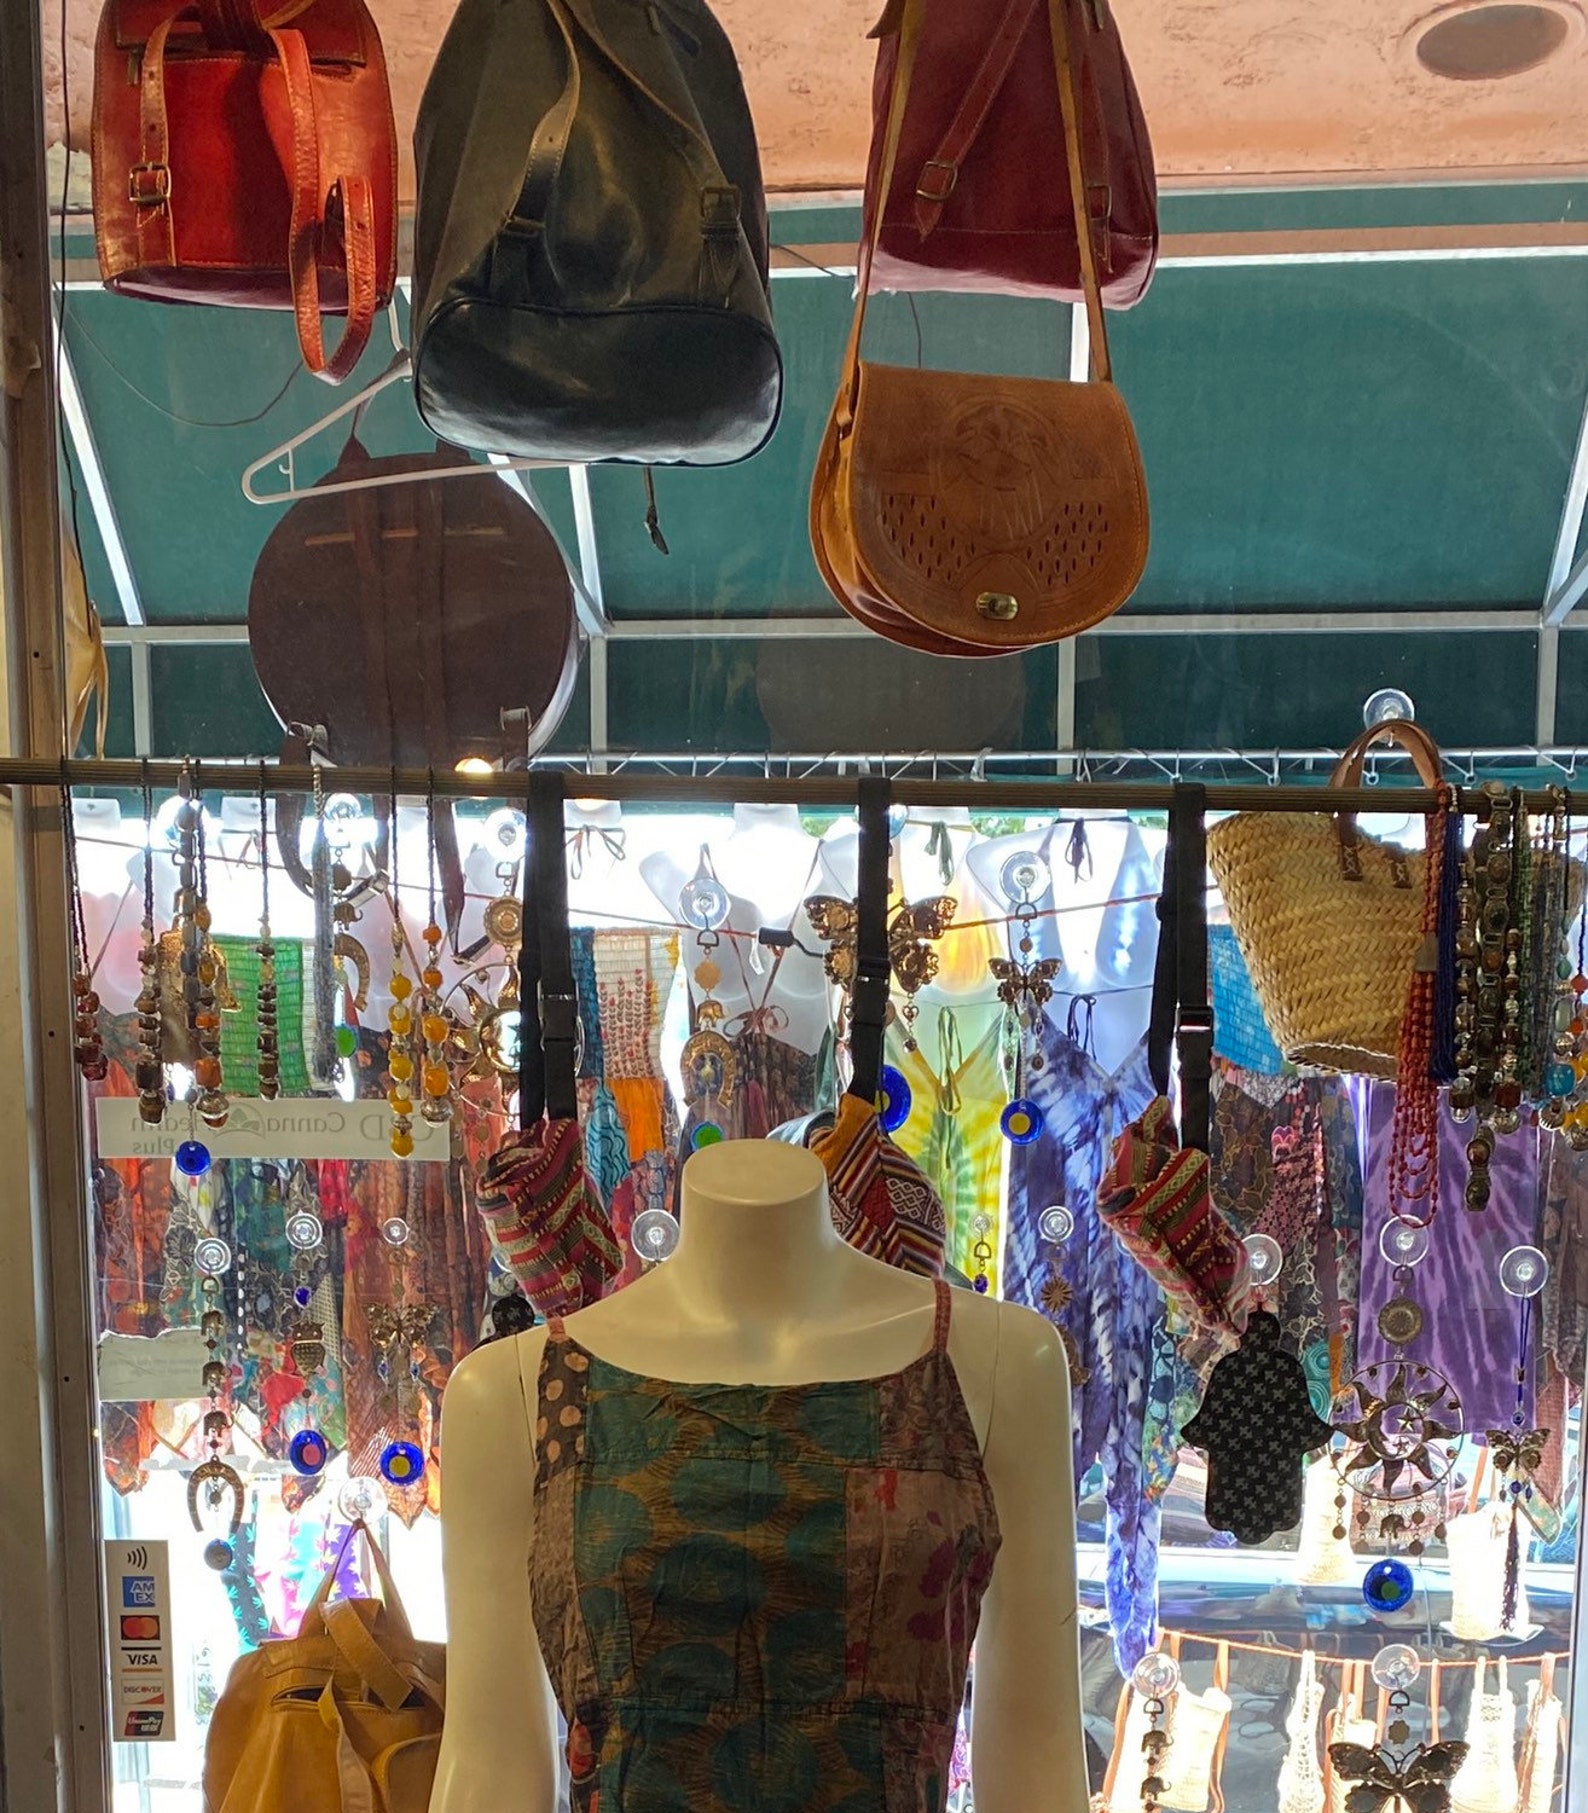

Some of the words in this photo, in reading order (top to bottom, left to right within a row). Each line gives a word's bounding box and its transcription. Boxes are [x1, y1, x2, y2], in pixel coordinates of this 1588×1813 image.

[131, 1581, 154, 1593] AM
[134, 1592, 154, 1603] EX
[127, 1654, 158, 1665] VISA
[123, 1686, 162, 1694] DISCOVER
